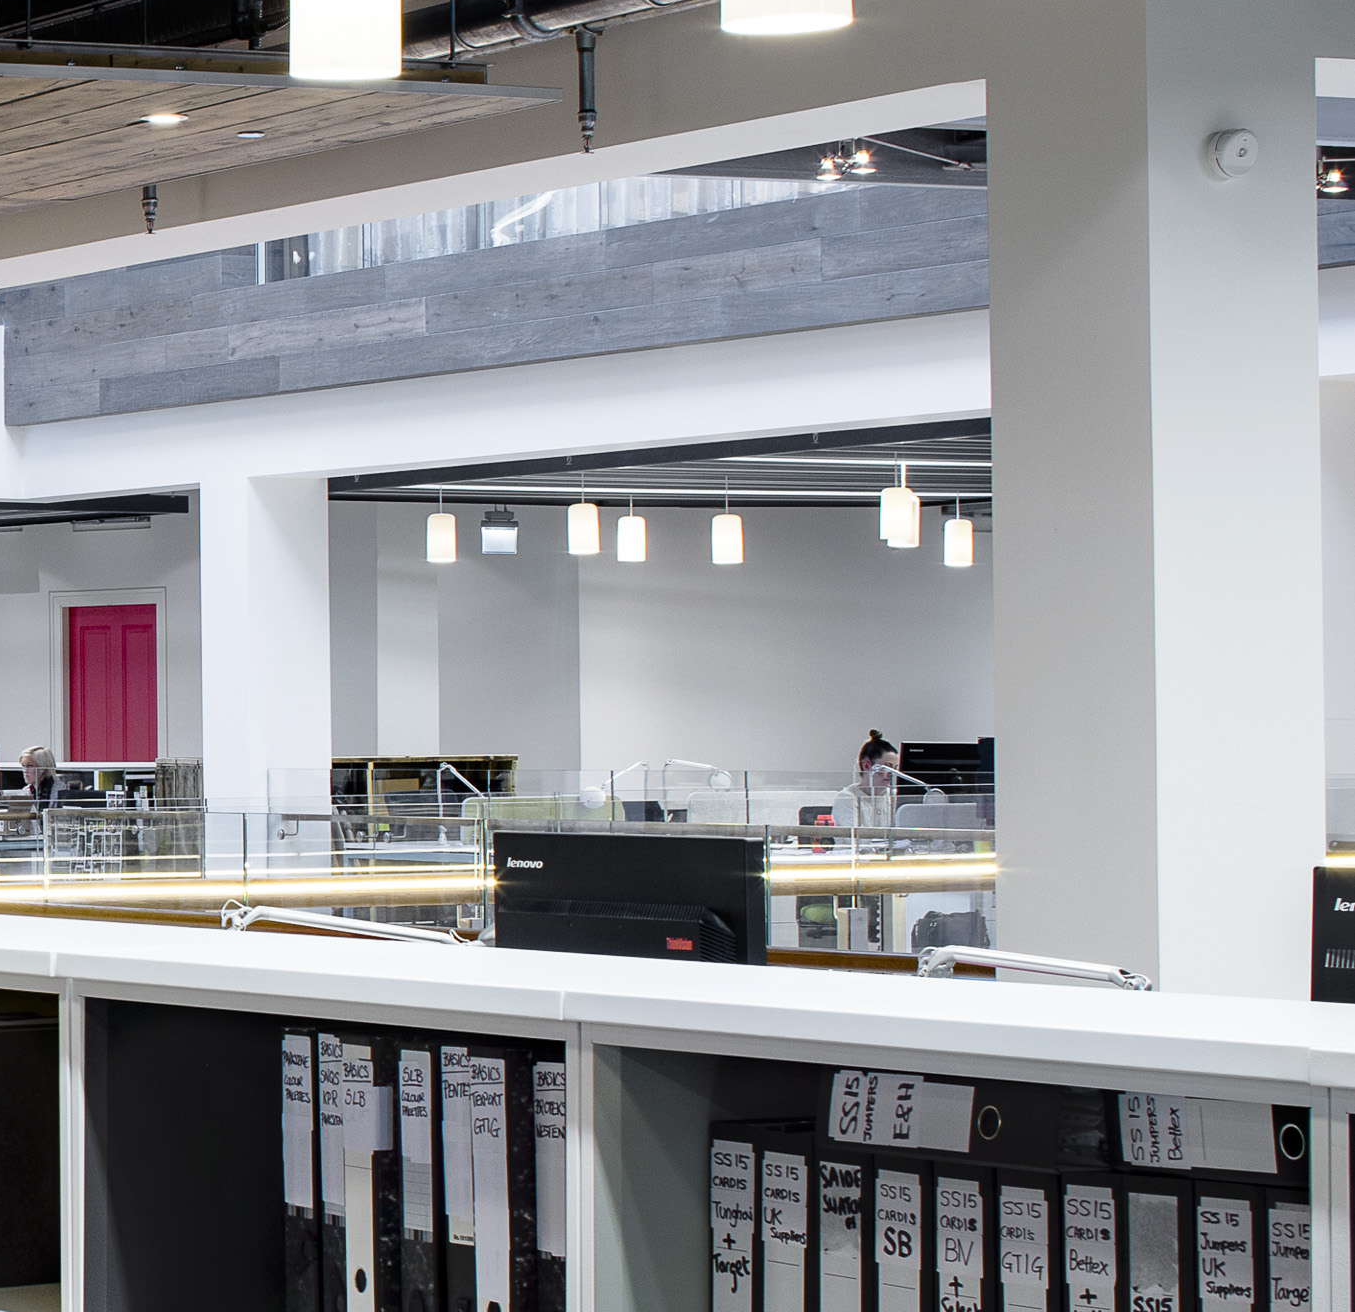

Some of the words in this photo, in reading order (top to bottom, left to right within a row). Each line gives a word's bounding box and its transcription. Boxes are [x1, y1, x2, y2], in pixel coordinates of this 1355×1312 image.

[506, 857, 544, 869] lenovo
[320, 1040, 343, 1059] BASICS
[442, 1051, 471, 1068] BASICS
[343, 1062, 369, 1079] BASICS
[402, 1067, 424, 1083] SLB
[470, 1063, 501, 1081] BASICS
[536, 1071, 566, 1087] BASICS
[344, 1088, 366, 1108] SLB
[863, 1075, 878, 1142] JUMPERS
[892, 1082, 916, 1140] E&H
[1146, 1095, 1160, 1163] JUMPERS
[711, 1175, 747, 1191] CARDIS
[764, 1187, 800, 1203] CARDIS
[940, 1190, 978, 1209] SS15
[763, 1206, 782, 1226] UK
[877, 1208, 917, 1226] CARDIS
[1066, 1198, 1112, 1220] SS15
[940, 1214, 978, 1232] CARDIS
[883, 1226, 912, 1258] SB
[1066, 1225, 1111, 1241] CARDIS
[1200, 1232, 1247, 1253] Jumpers
[1271, 1240, 1310, 1260] Jumpe
[711, 1253, 751, 1294] Target
[1201, 1257, 1226, 1277] UK
[1205, 1281, 1252, 1300] Suppliers
[1271, 1277, 1310, 1307] Targe
